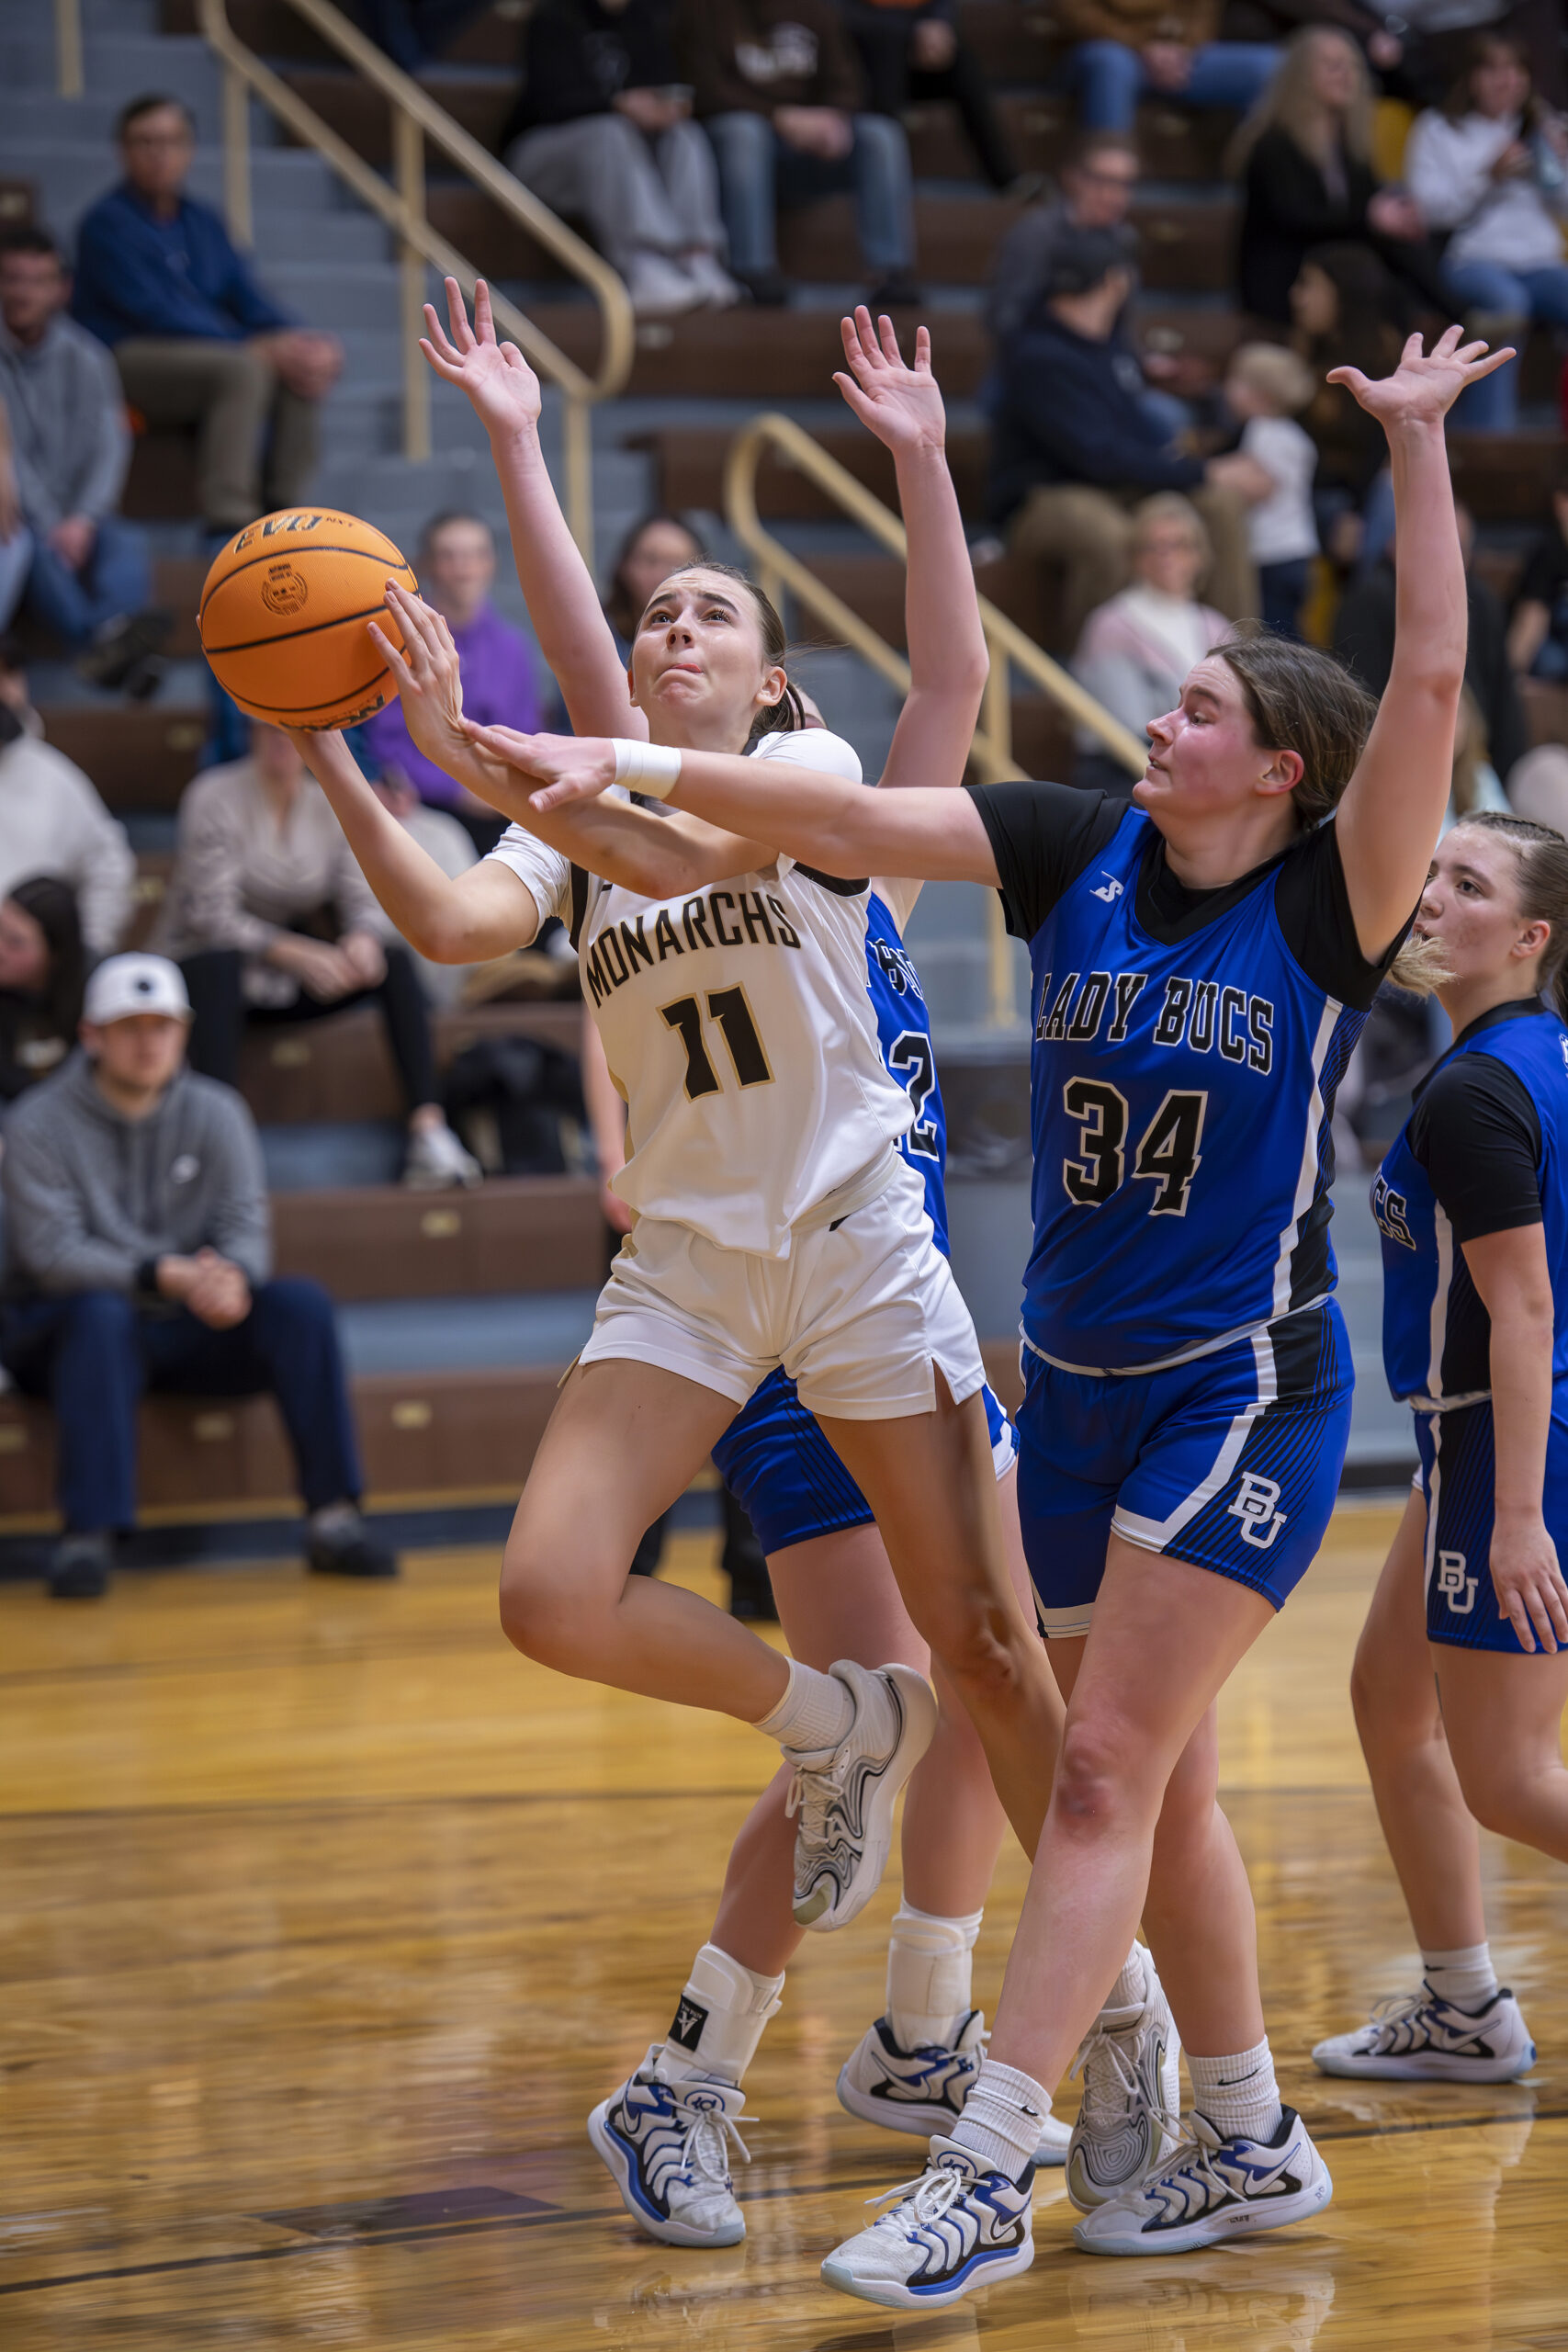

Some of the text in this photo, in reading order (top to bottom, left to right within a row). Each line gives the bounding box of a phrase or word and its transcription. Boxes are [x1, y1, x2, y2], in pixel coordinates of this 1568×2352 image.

[586, 891, 801, 1009] MONARCHS
[655, 980, 777, 1104] 11
[1036, 970, 1275, 1077] LADY BUCS
[877, 1029, 941, 1163] 2
[1063, 1076, 1209, 1217] 34
[1370, 1165, 1416, 1251] CS
[1227, 1471, 1288, 1550] BU
[1438, 1549, 1480, 1615] BU
